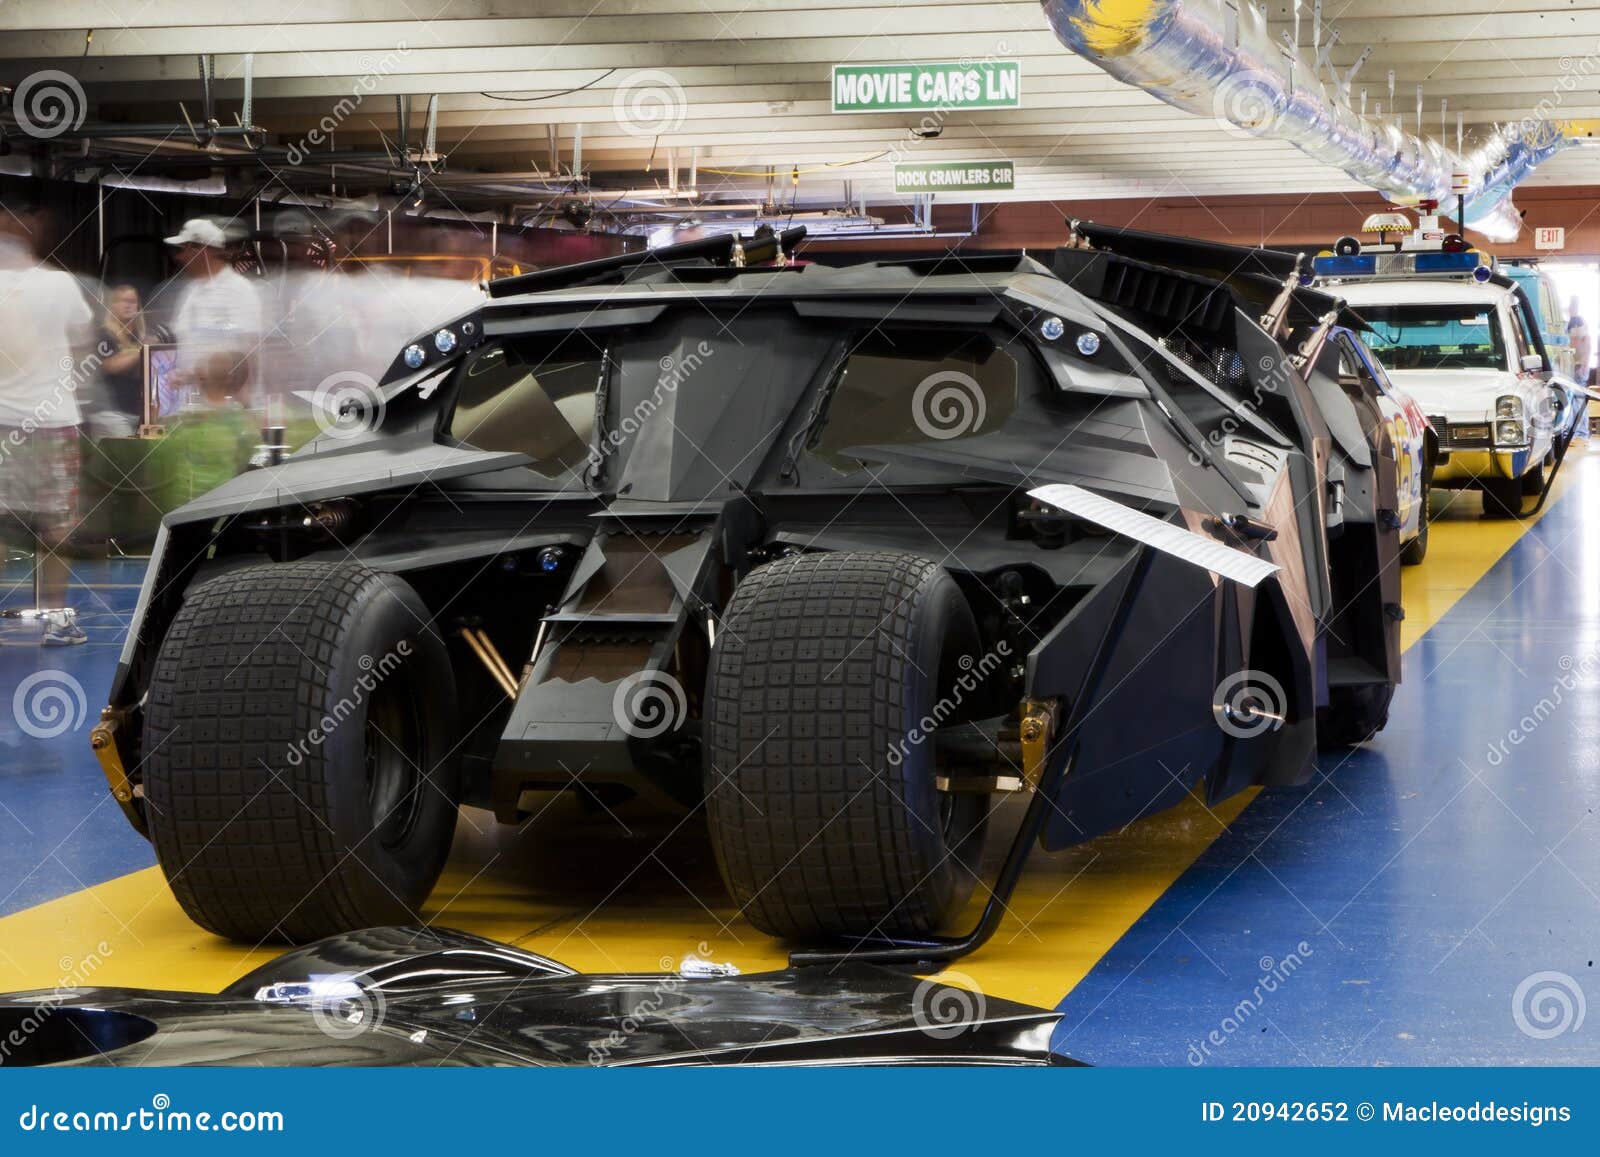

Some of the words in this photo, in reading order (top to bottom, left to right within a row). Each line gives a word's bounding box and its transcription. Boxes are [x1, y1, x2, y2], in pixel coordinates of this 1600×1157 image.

[836, 72, 912, 105] MOVIE
[917, 70, 981, 102] CARS
[985, 69, 1017, 100] LN
[896, 171, 928, 186] ROCK
[929, 169, 990, 185] CRAWLERS
[992, 168, 1013, 183] CIR
[1541, 229, 1560, 243] EXIT
